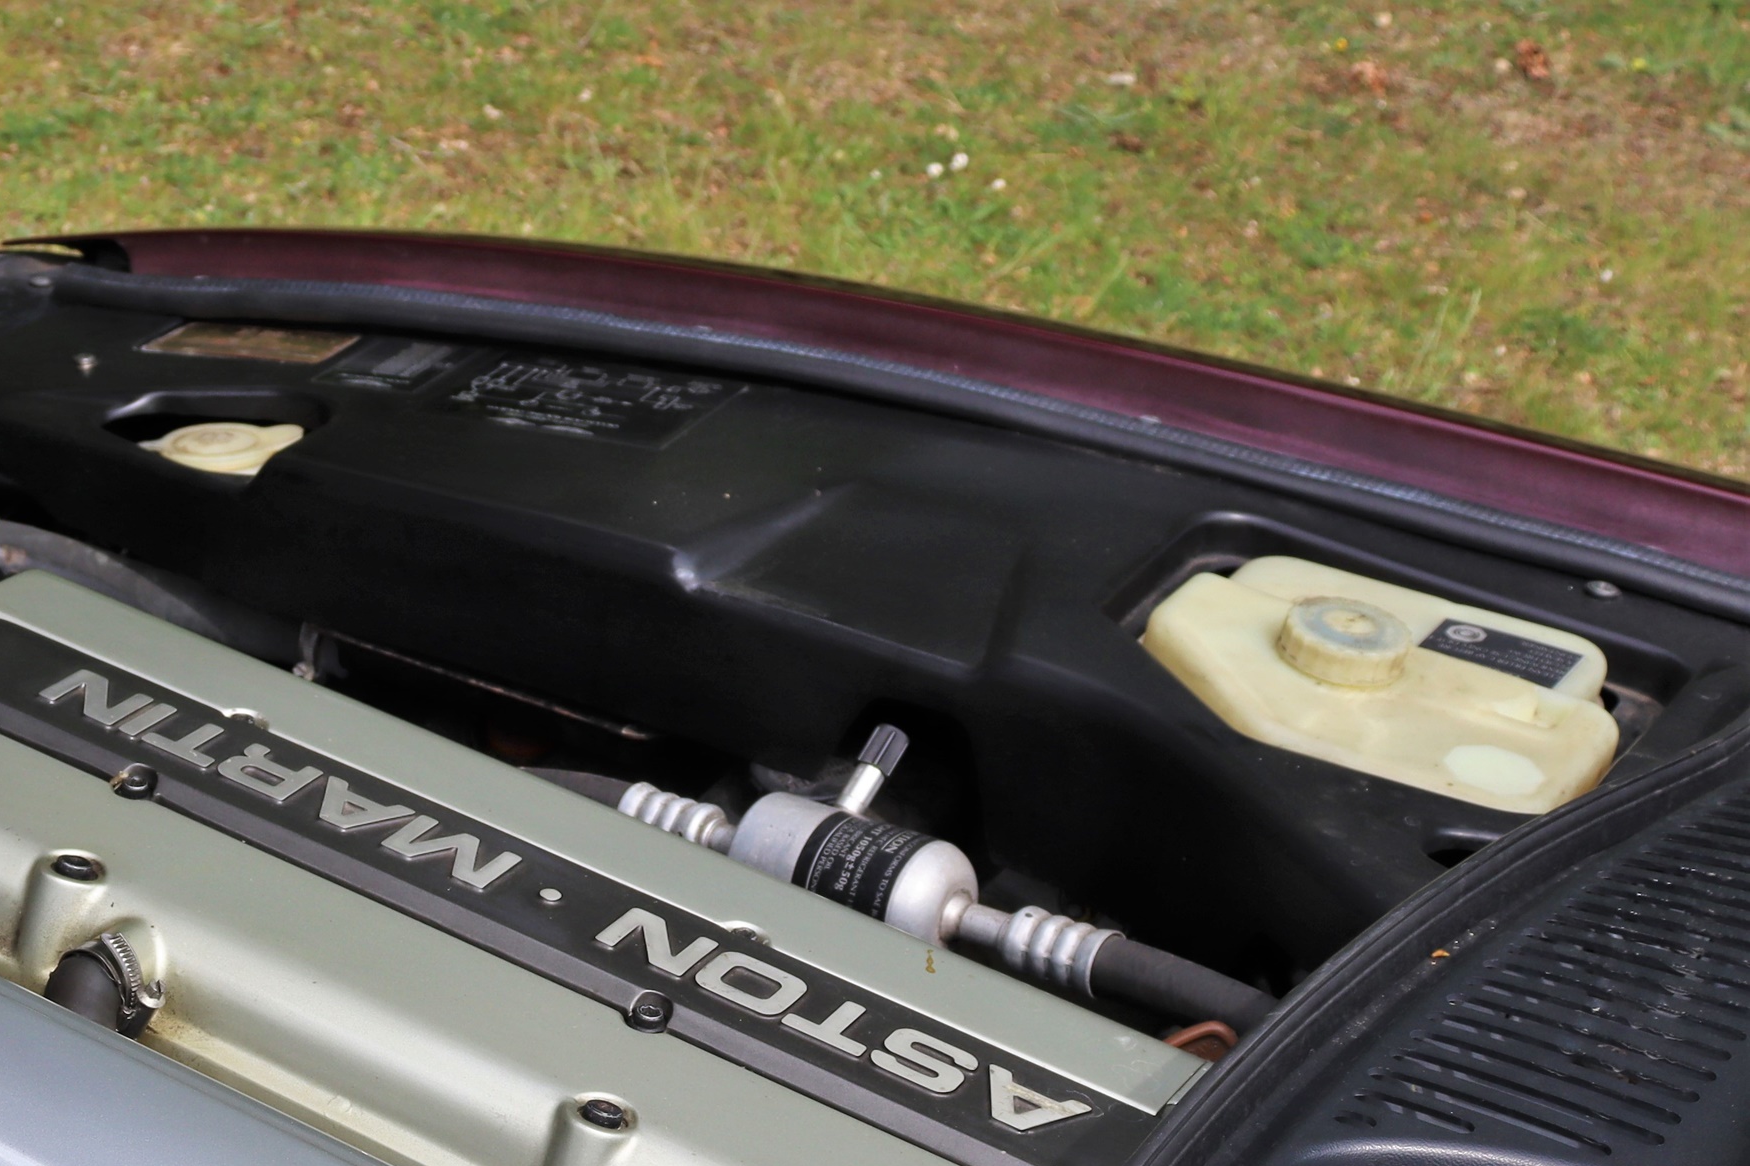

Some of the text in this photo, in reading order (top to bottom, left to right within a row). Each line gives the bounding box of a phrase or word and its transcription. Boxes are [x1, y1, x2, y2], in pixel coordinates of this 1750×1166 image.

[830, 834, 850, 856] BASED
[810, 855, 826, 891] PERSON
[848, 844, 878, 896] REFRIGERANT
[877, 878, 889, 891] TO
[39, 669, 1093, 1131] ASTON MARTIN
